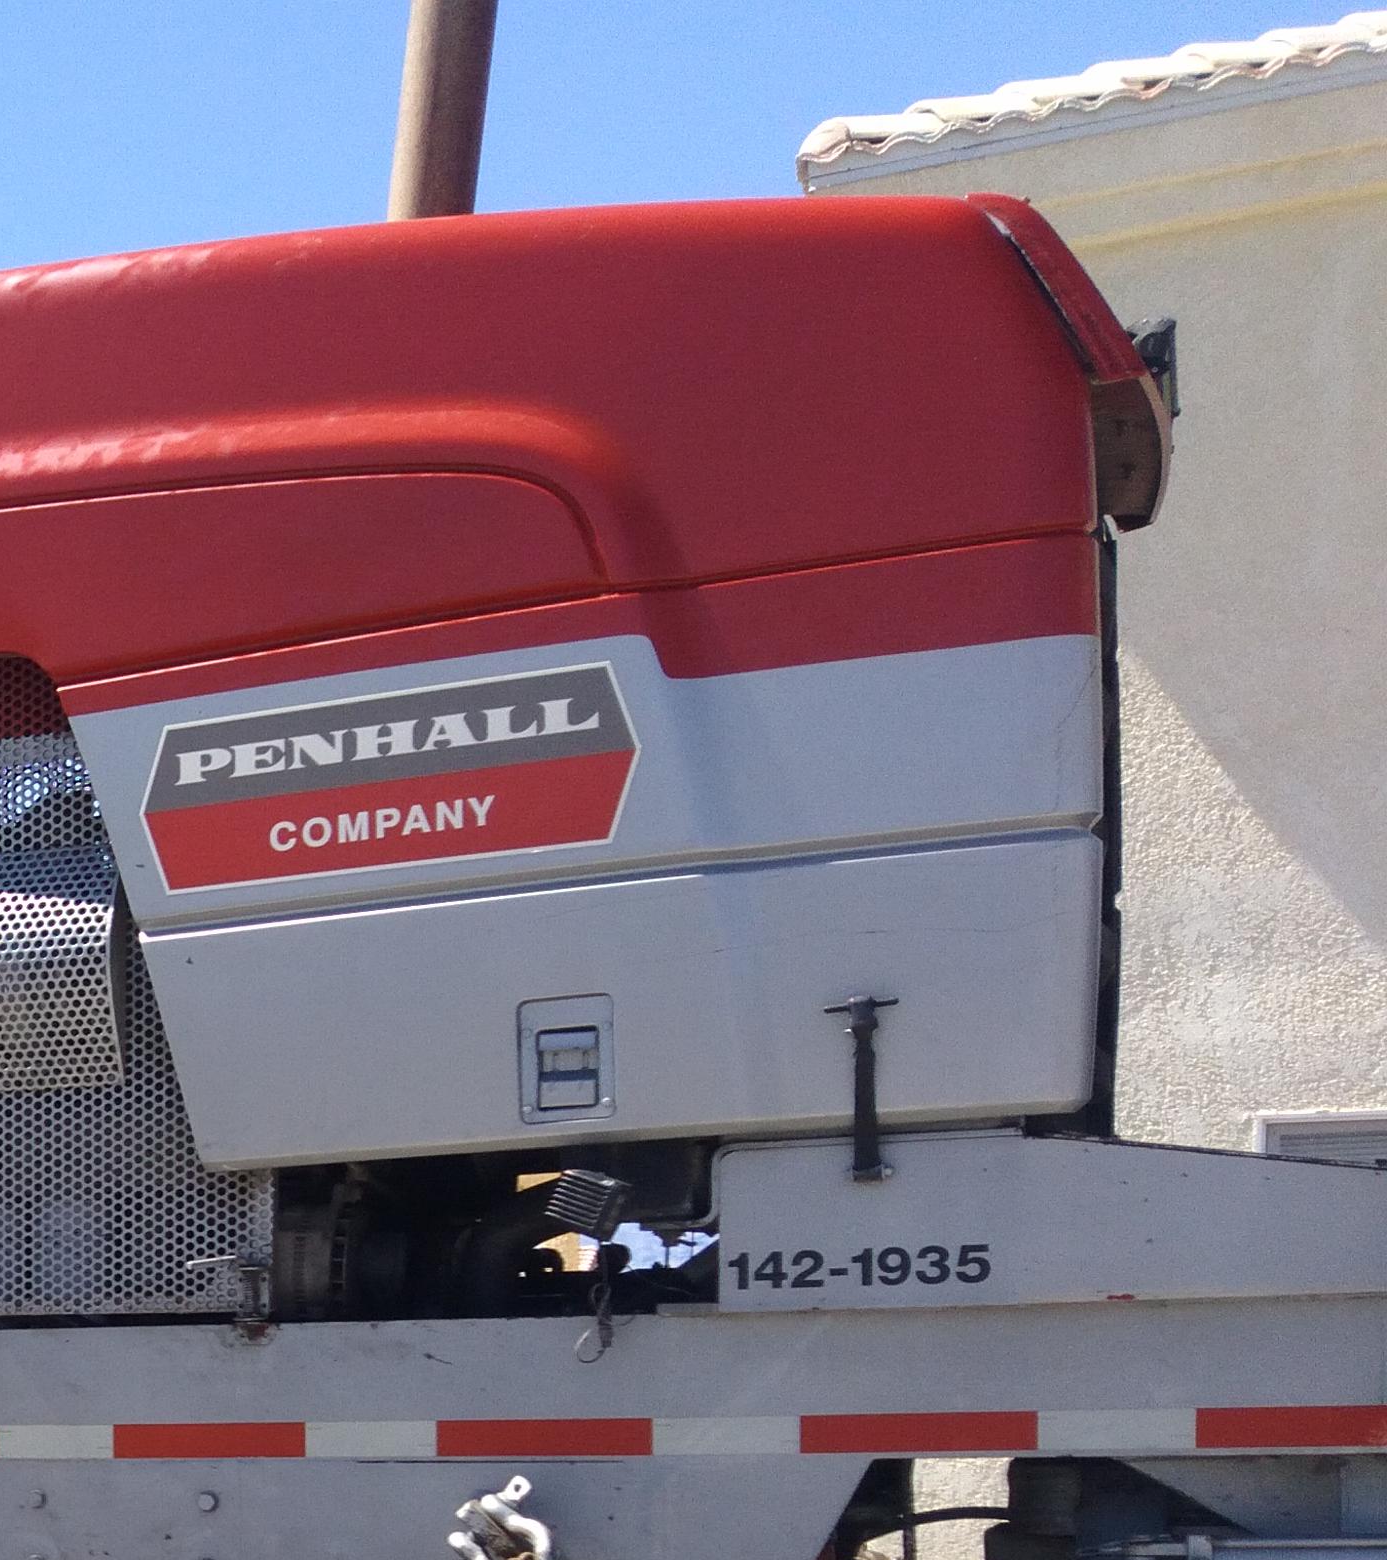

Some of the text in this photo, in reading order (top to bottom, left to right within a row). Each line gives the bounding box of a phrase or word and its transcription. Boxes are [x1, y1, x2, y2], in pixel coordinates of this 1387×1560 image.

[174, 698, 600, 787] PENHALL
[268, 794, 497, 852] COMPANY
[728, 1243, 992, 1290] 142-1935
